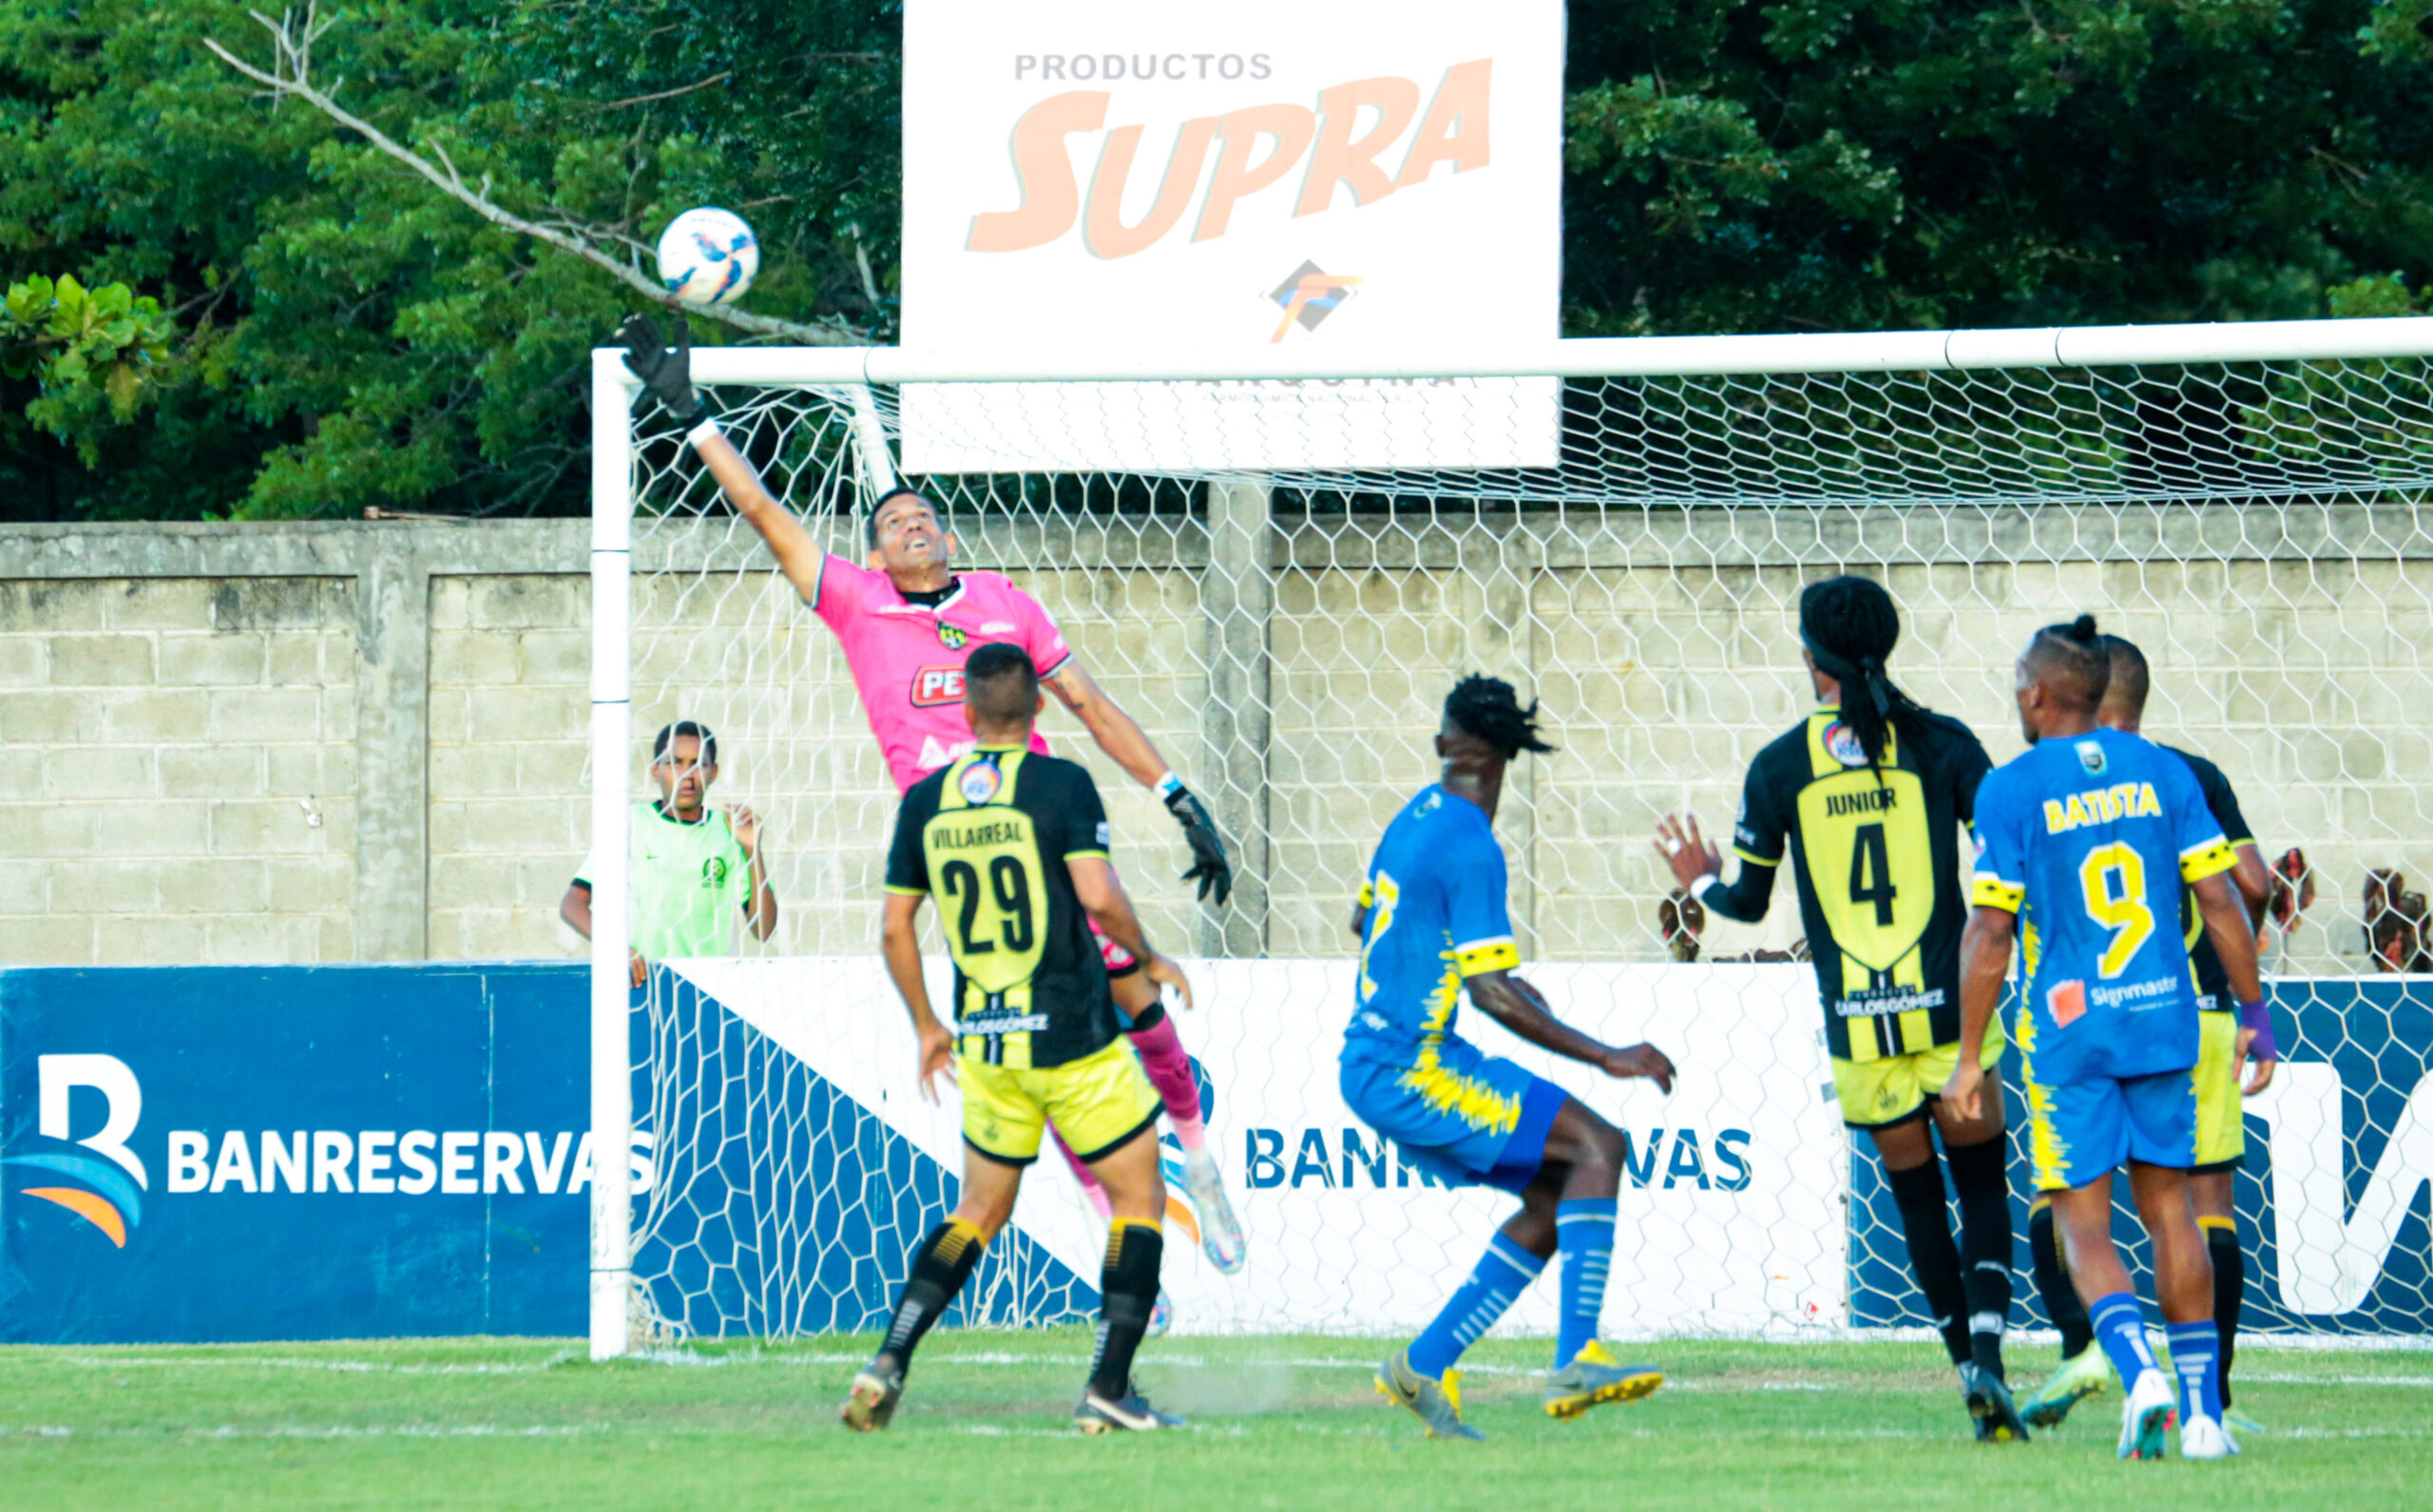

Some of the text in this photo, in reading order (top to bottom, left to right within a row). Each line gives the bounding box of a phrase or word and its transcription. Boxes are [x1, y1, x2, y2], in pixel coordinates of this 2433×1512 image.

[1014, 52, 1274, 81] PRODUCTOS
[964, 56, 1493, 260] SUPRA
[922, 670, 966, 699] PE
[1826, 787, 1898, 818] JUNIOR
[2042, 781, 2163, 835] BATISTA
[931, 821, 1025, 851] VILLARREAL
[1849, 822, 1898, 928] 4
[941, 854, 1035, 956] 29
[2079, 840, 2156, 980] 9
